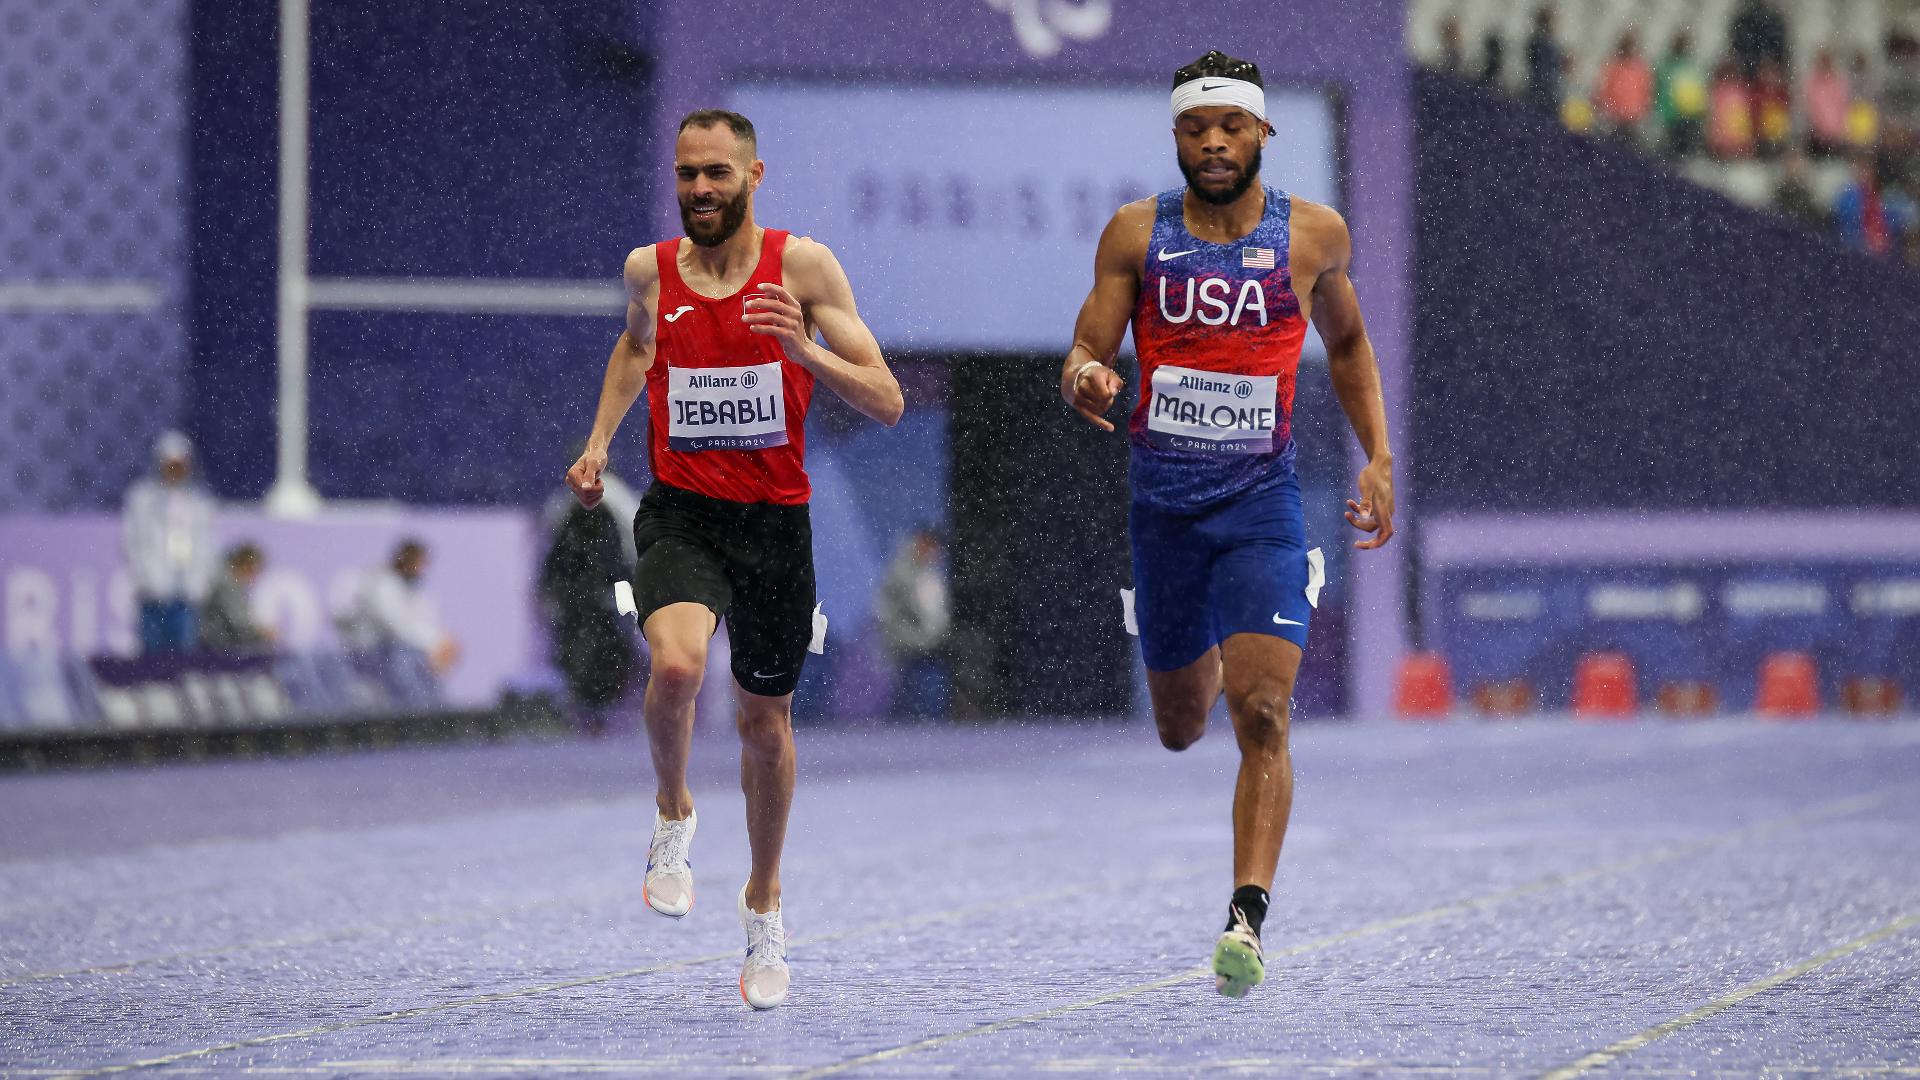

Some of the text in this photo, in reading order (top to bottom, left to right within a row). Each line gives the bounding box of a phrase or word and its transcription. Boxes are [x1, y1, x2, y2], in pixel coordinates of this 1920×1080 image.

[1159, 276, 1268, 327] USA
[688, 375, 738, 389] Allianz
[1179, 375, 1231, 394] Allianz
[674, 395, 777, 426] JEBABLI
[1154, 393, 1272, 430] MALONE
[739, 438, 765, 447] 2024
[1187, 440, 1247, 452] PARIS 2024
